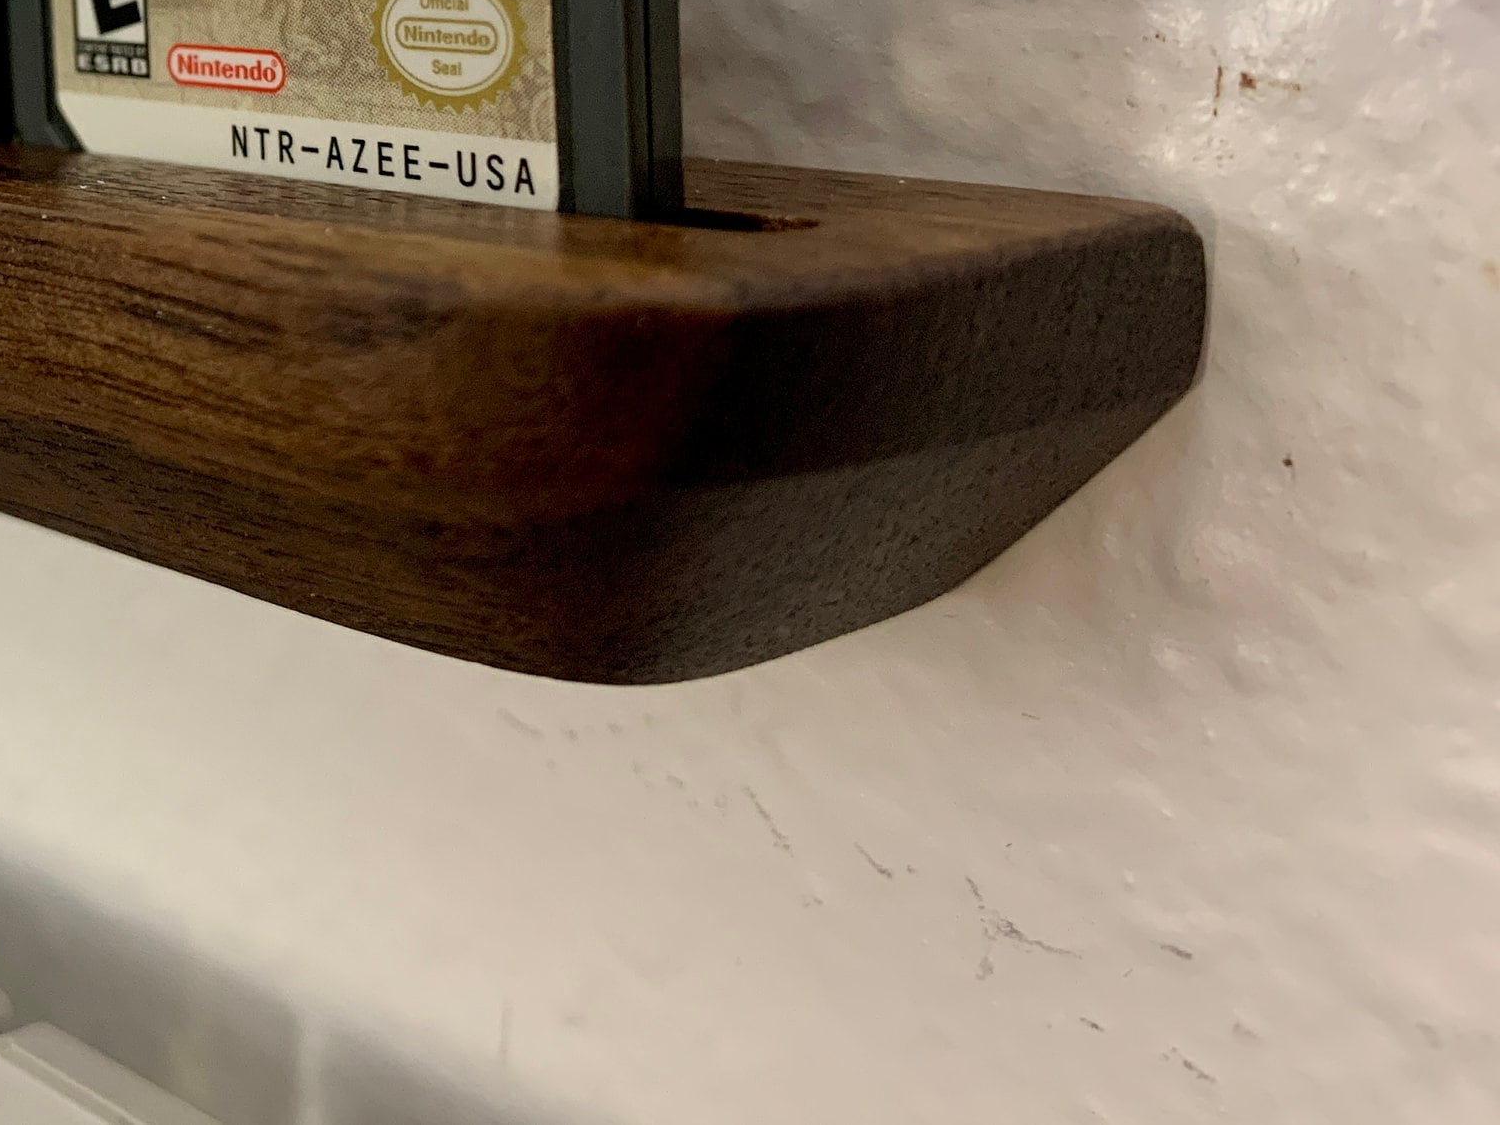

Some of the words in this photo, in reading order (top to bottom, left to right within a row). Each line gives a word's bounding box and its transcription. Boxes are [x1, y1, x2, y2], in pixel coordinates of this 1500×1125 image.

[403, 24, 491, 48] Nintendo
[176, 53, 277, 83] Nintendo
[431, 58, 463, 76] Seal
[231, 124, 536, 196] NTR-AZEE-USA
